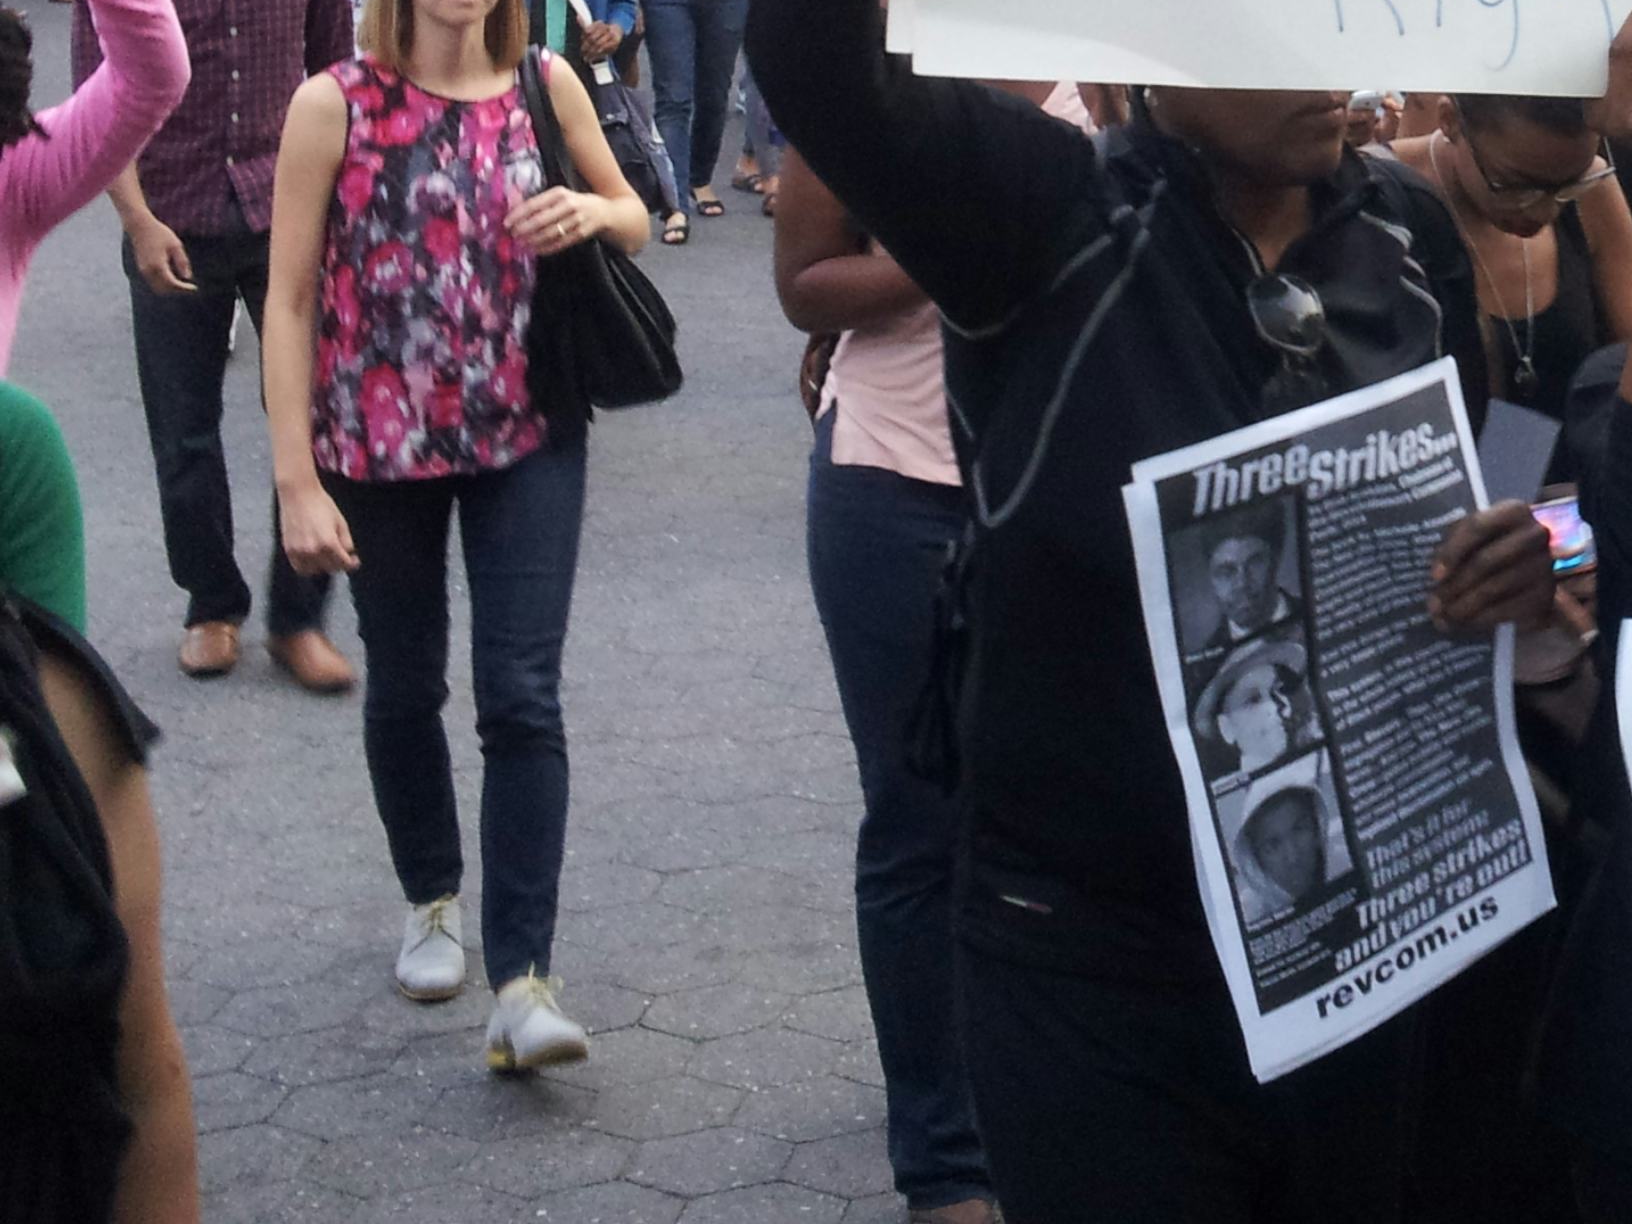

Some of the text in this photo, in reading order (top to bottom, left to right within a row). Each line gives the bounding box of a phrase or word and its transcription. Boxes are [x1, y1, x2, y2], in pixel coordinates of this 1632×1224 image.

[1356, 872, 1431, 931] Three
[1432, 818, 1522, 884] strikes
[1315, 895, 1500, 1020] revcom.us
[1334, 921, 1388, 974] and
